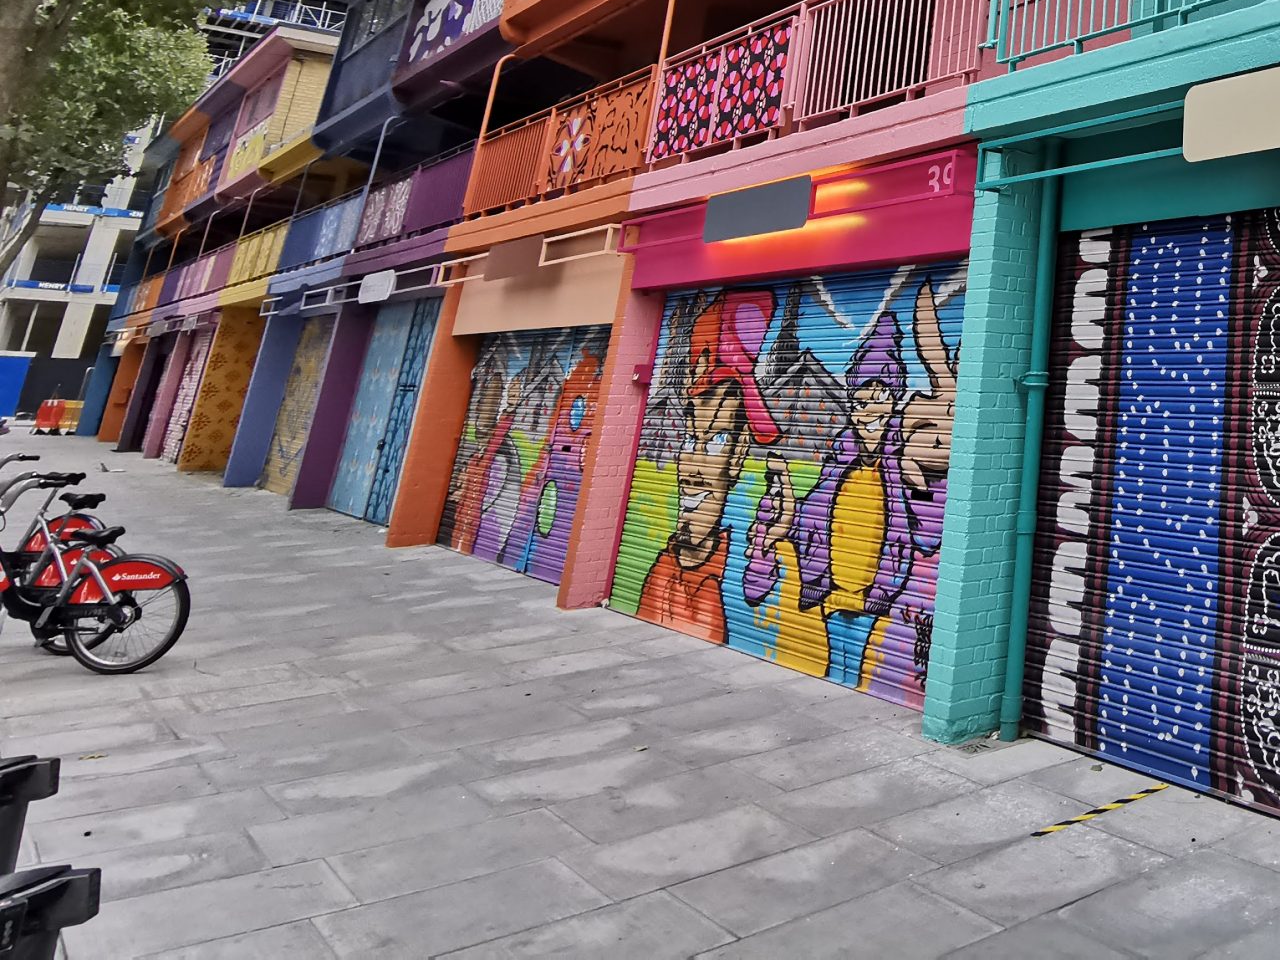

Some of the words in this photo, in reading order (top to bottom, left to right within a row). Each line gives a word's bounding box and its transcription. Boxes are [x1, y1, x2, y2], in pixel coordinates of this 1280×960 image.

[63, 203, 88, 213] HENRY
[38, 282, 66, 290] HENRY
[120, 571, 162, 581] Santander
